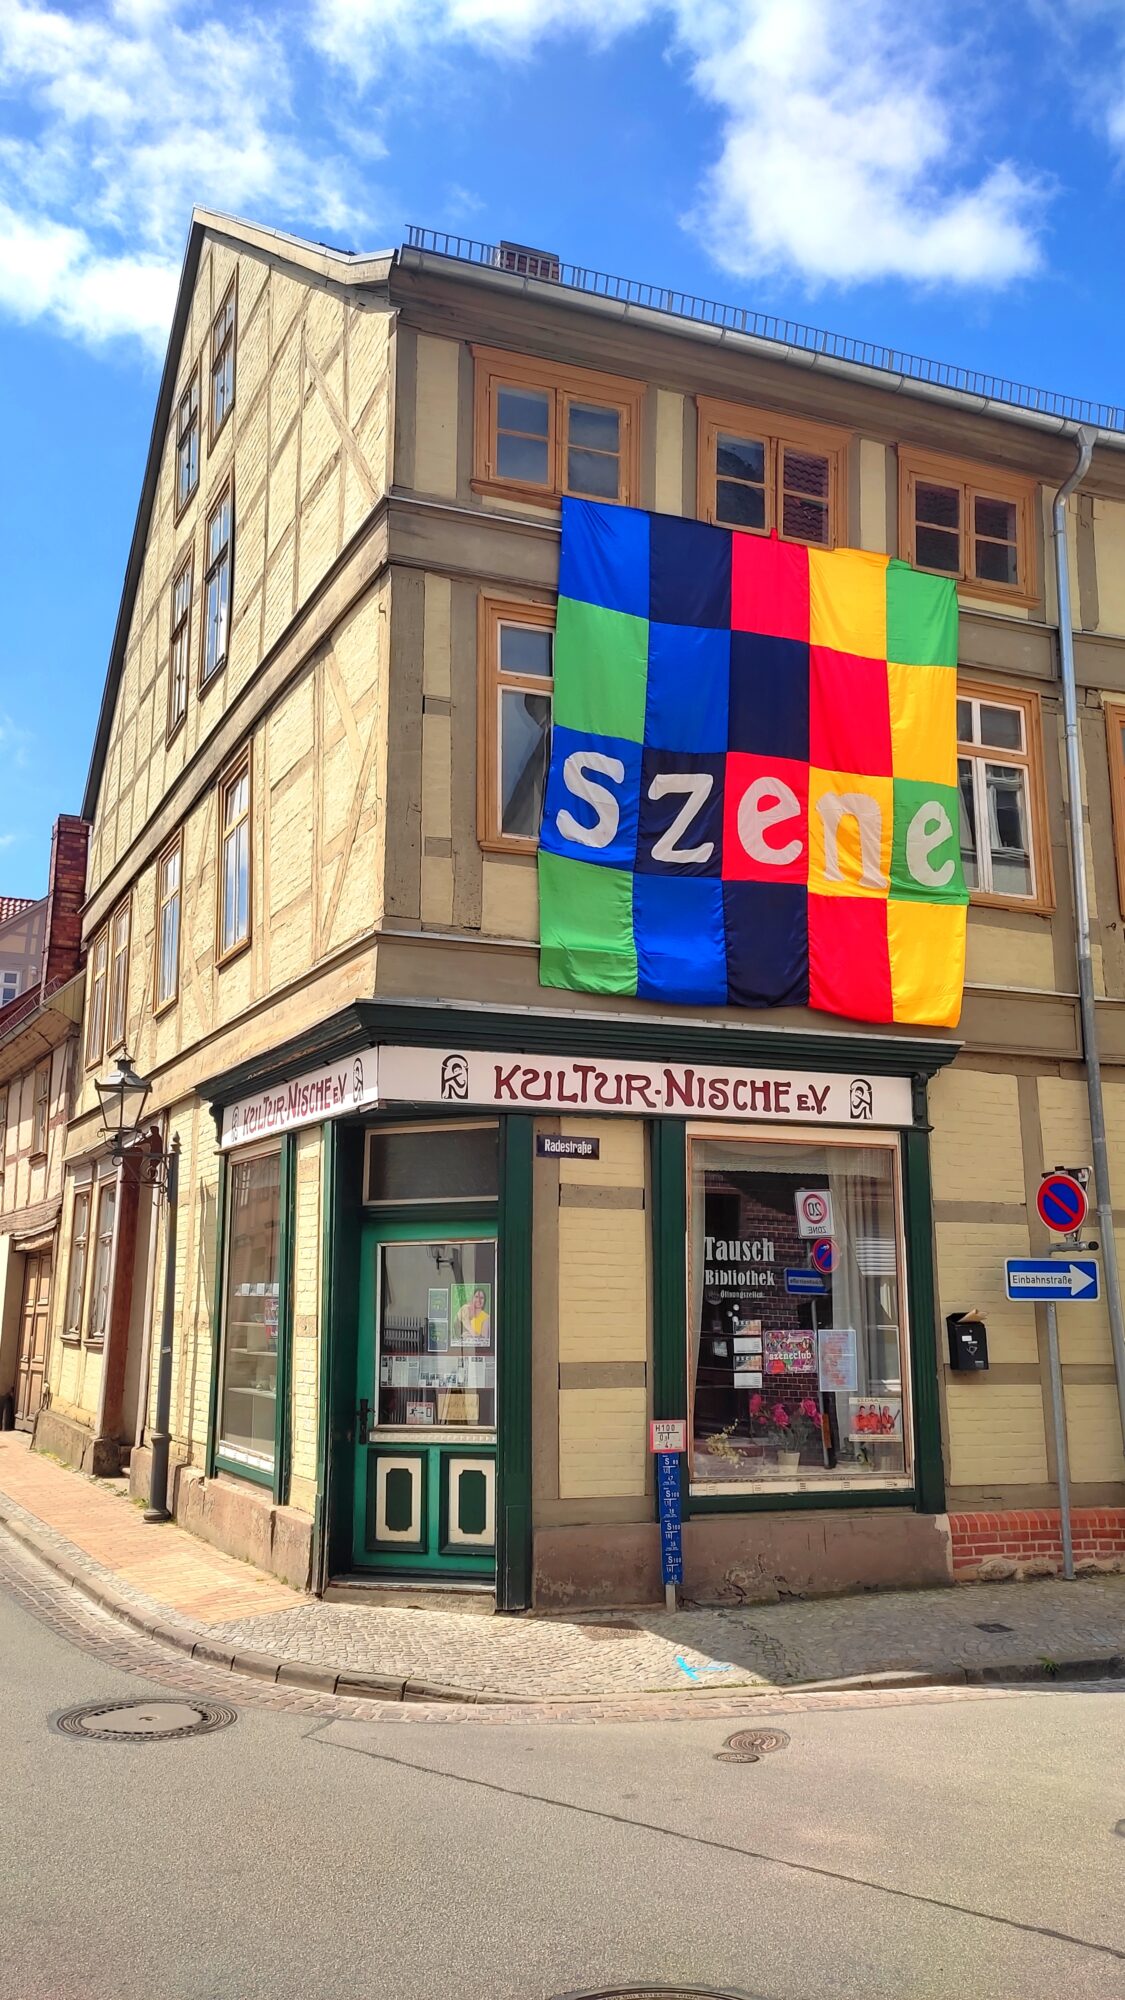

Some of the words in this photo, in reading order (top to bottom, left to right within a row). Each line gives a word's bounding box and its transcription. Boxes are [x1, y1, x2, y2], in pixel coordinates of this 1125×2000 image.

[544, 1139, 592, 1155] Radestraße
[704, 1236, 775, 1262] Tausch
[705, 1269, 775, 1286] Bibliothek
[1012, 1274, 1073, 1285] Einbahnstraße
